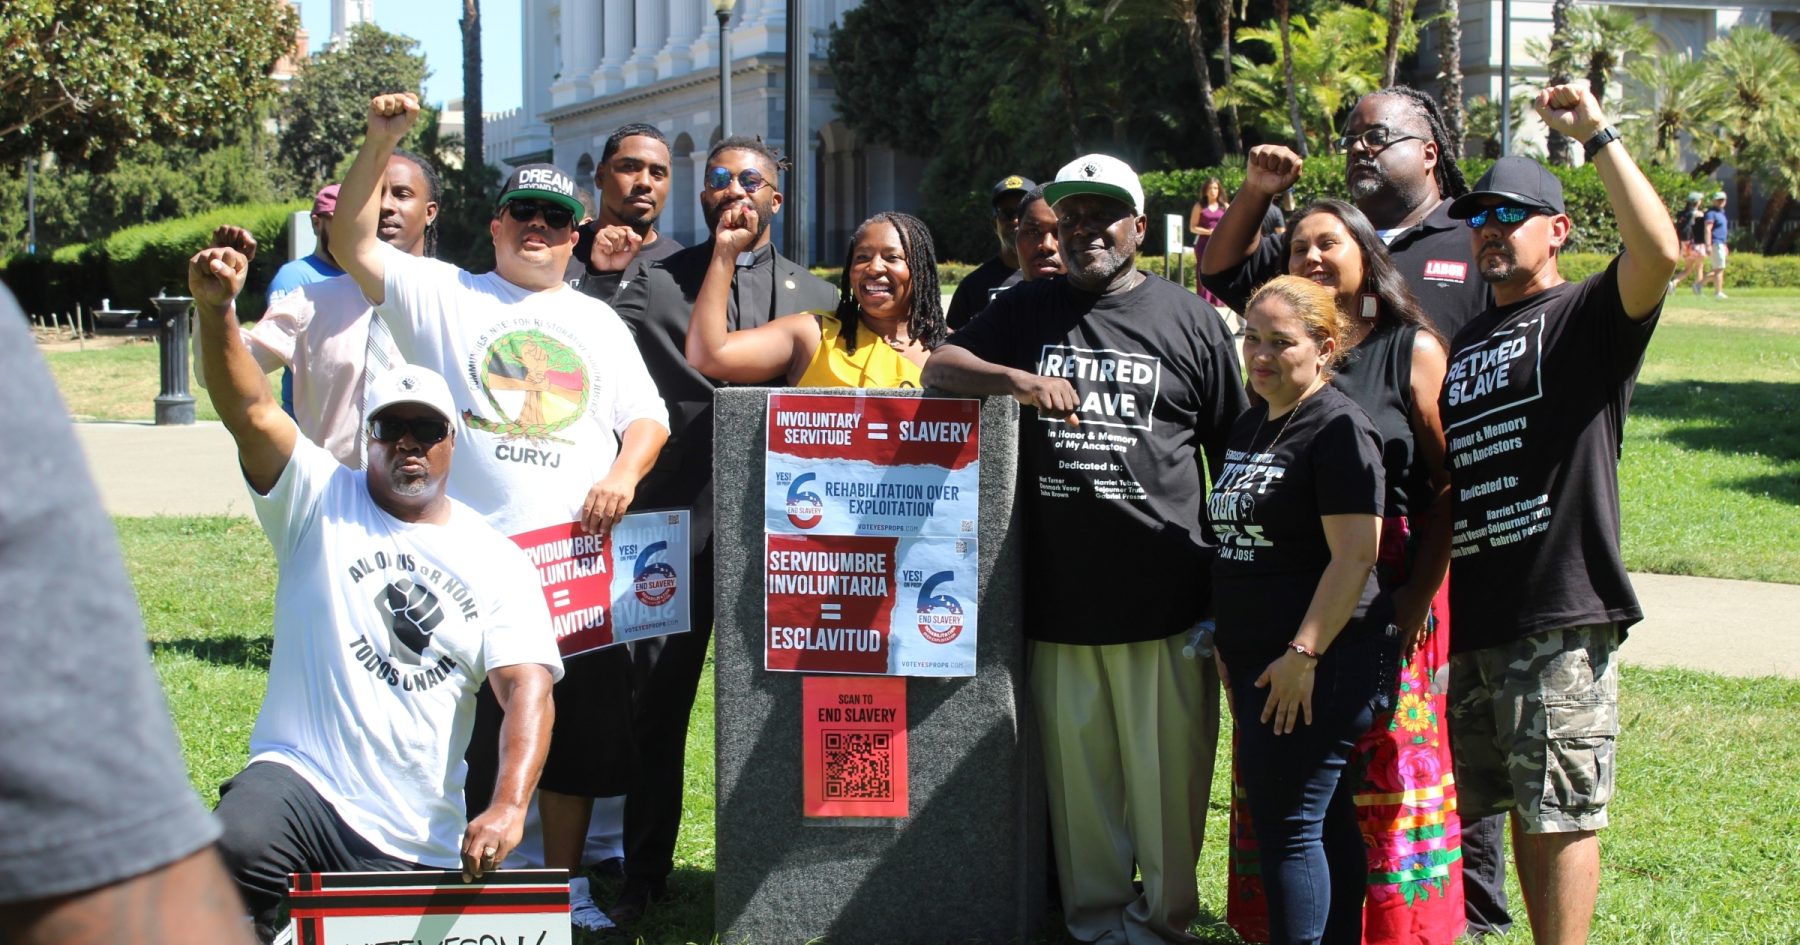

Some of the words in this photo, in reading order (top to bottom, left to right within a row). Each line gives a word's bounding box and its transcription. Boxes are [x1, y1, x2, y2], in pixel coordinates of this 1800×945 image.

[519, 169, 573, 196] DREAM
[1426, 261, 1464, 276] LABOR
[1044, 354, 1154, 385] RETIRED
[1448, 362, 1510, 406] SLAVE
[1079, 392, 1136, 418] AVE
[776, 411, 862, 429] INVOLUNTARY
[1476, 430, 1484, 442] &
[1483, 416, 1527, 440] Memory
[784, 429, 852, 446] SERVITUDE
[868, 422, 888, 440] =
[899, 420, 972, 442] SLAVERY
[1048, 429, 1056, 438] In
[1058, 430, 1086, 440] Honor
[1088, 432, 1095, 440] &
[1098, 432, 1138, 446] Memory
[496, 444, 560, 468] CURYJ
[1055, 440, 1064, 448] of
[1066, 440, 1080, 450] My
[1082, 441, 1127, 453] Ancestors
[1460, 452, 1472, 466] My
[1473, 436, 1522, 462] Ancestors
[776, 472, 792, 480] YES!
[1058, 460, 1108, 470] Dedicated
[1110, 464, 1122, 472] to:
[786, 472, 823, 529] 6
[825, 482, 928, 500] REHABILITATION
[929, 485, 959, 501] OVER
[1460, 478, 1502, 502] Dedicated
[1503, 476, 1518, 489] to:
[849, 500, 934, 517] EXPLOITATION
[1211, 492, 1240, 520] OUR
[1486, 504, 1514, 520] Harriet
[1515, 494, 1548, 512] Tubman
[1488, 515, 1530, 534] Sojourner
[524, 534, 604, 565] RVIDUMBRE
[619, 544, 638, 556] YES!
[1490, 530, 1522, 547] Gabriel
[770, 550, 886, 574] SERVIDUMBRE
[1220, 546, 1233, 559] SAN
[540, 554, 606, 587] LUNTARIA
[634, 540, 676, 606] 6
[903, 570, 922, 582] YES!
[396, 554, 416, 572] US
[442, 578, 478, 622] NONE
[636, 582, 648, 590] END
[648, 580, 674, 590] SLAVERY
[769, 574, 888, 597] INVOLUNTARIA
[552, 589, 570, 608] =
[917, 570, 964, 644] 6
[553, 606, 604, 638] AVITUD
[820, 604, 841, 620] =
[919, 616, 932, 624] END
[932, 616, 961, 624] SLAVERY
[771, 626, 880, 652] ESCLAVITUD
[349, 634, 400, 686] TODOS
[838, 694, 860, 704] SCAN
[862, 694, 872, 704] TO
[818, 708, 842, 722] END
[845, 708, 896, 722] SLAVERY
